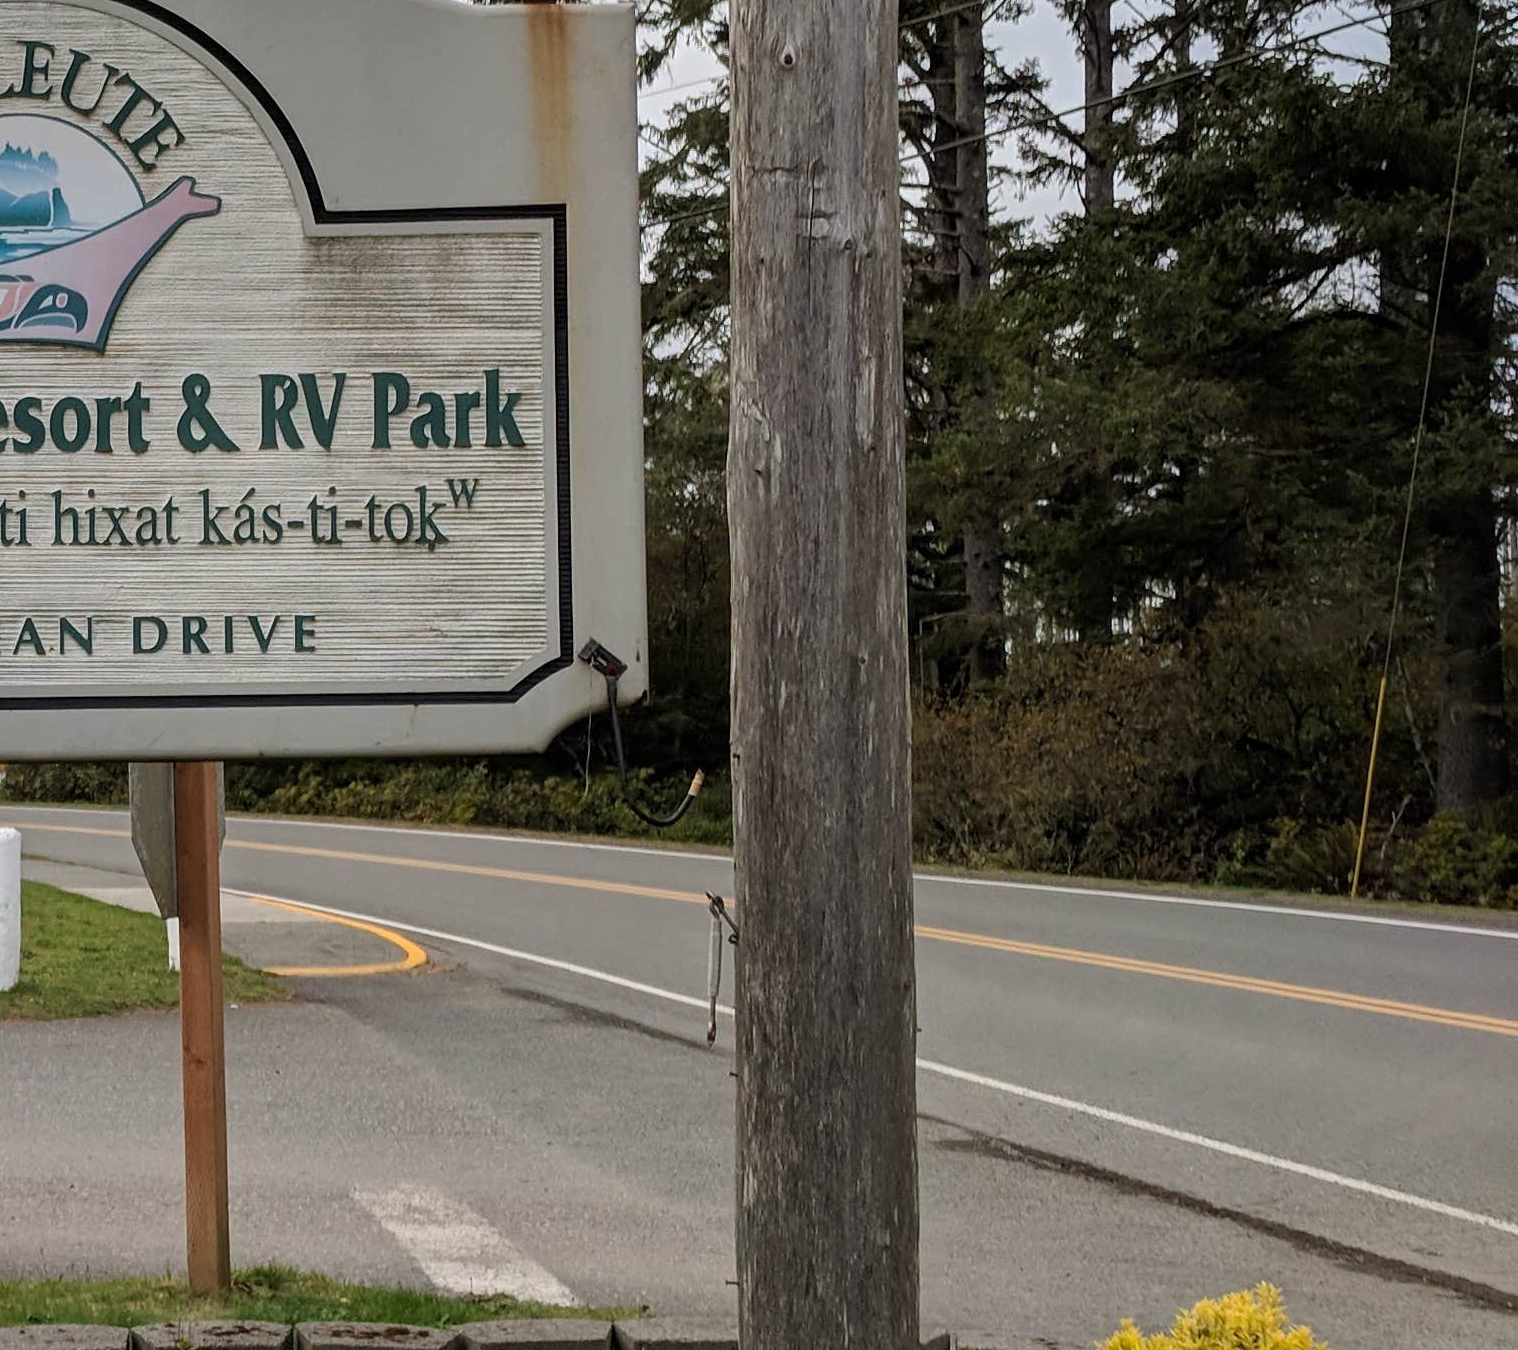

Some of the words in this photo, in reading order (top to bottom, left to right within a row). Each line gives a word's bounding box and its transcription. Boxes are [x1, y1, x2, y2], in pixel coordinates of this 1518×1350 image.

[176, 373, 240, 452] &
[258, 372, 347, 451] RV
[372, 368, 527, 449] Park
[52, 489, 181, 547] hixat
[132, 615, 317, 655] DRIVE
